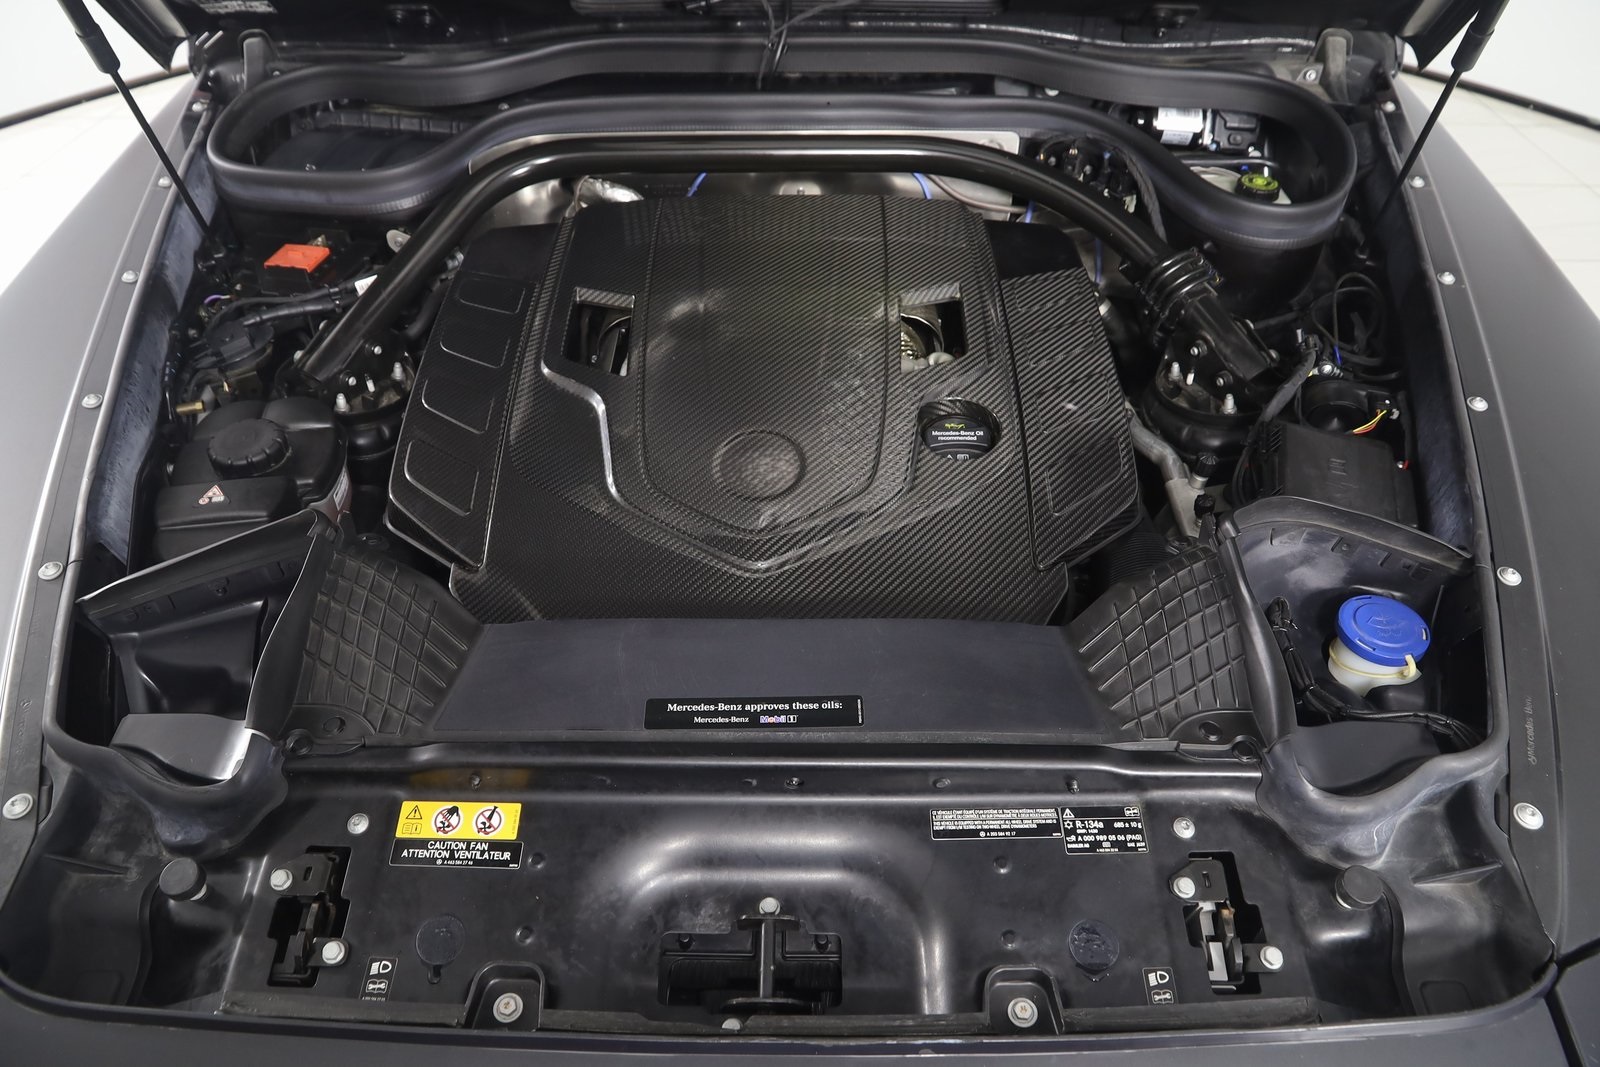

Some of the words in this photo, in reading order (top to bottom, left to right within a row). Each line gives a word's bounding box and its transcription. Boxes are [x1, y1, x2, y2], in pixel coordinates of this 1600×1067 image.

[667, 703, 743, 712] Mercedes-Benz
[744, 703, 790, 713] approves
[792, 702, 819, 710] these
[821, 701, 843, 709] oils:
[759, 715, 786, 723] Mobil
[1075, 820, 1104, 828] R-134a
[428, 841, 466, 850] CAUTION
[470, 842, 489, 850] FAN
[401, 849, 450, 859] ATTENTION
[454, 851, 511, 860] VENTILATEUR
